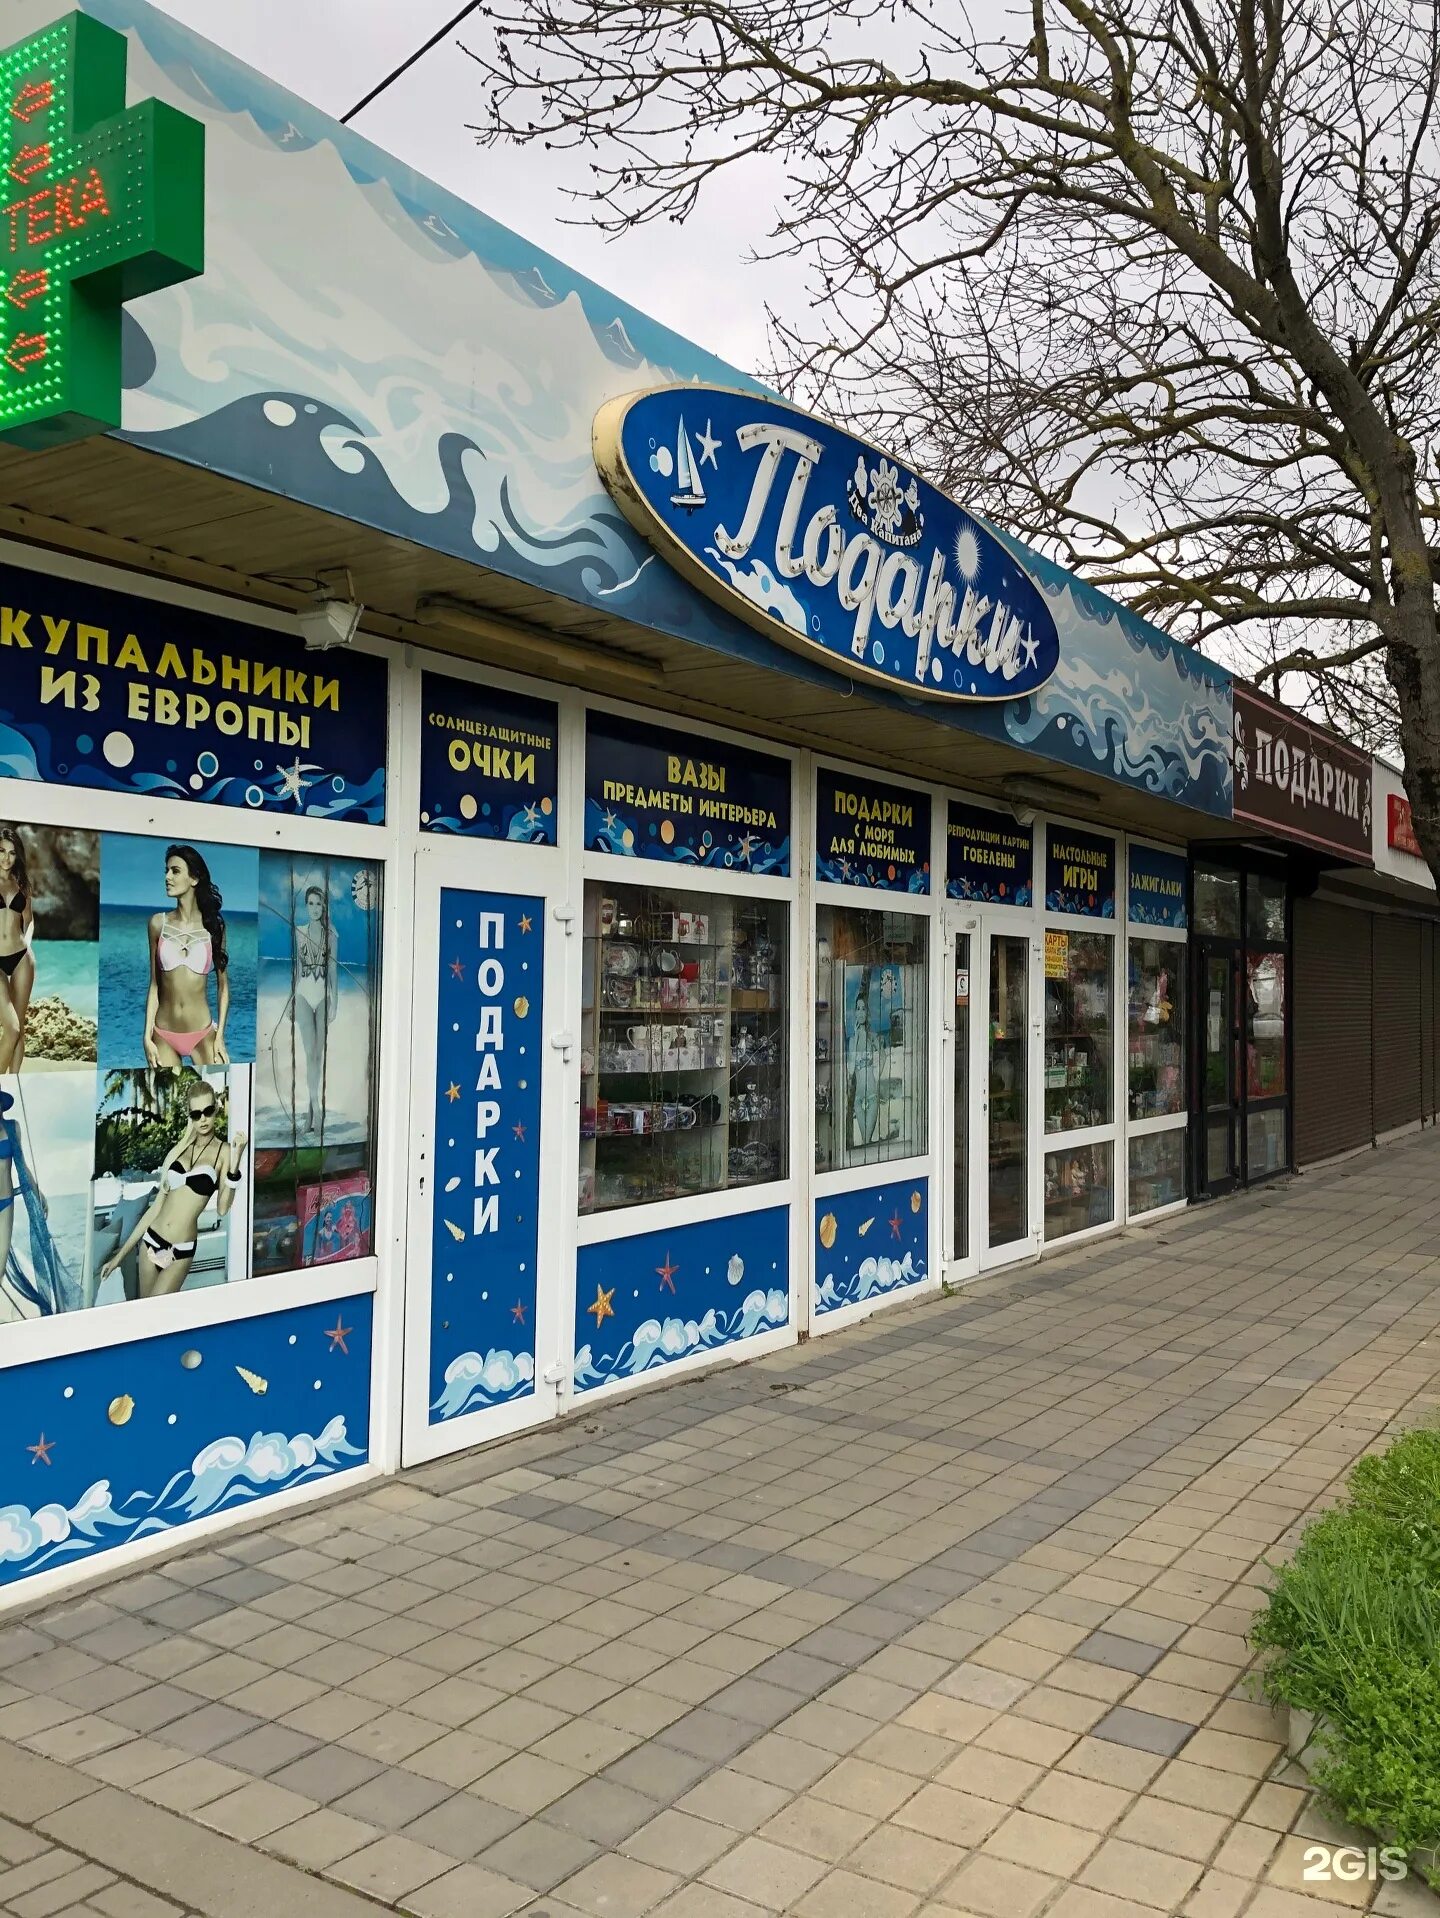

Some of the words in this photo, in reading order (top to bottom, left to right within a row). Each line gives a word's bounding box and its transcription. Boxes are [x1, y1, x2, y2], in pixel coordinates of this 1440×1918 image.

[870, 518, 923, 546] Капитана
[714, 423, 1026, 683] Подарки
[0, 606, 340, 712] КУПАЛЬНИКИ
[40, 666, 101, 712] ИЗ
[128, 682, 310, 749] ЕВРОПЫ
[428, 712, 551, 750] СОЛНЦЕЗАЩИТНЫЕ
[448, 739, 535, 785] ОЧКИ
[667, 755, 726, 793] ВАЗЫ
[1255, 727, 1359, 821] ПОДАРКИ
[603, 780, 693, 815] ПРЕДМЕТЫ
[699, 798, 777, 829] ИНТЕРЬЕРА
[834, 790, 913, 827] ПОДАРКИ
[830, 836, 855, 854] ДЛЯ
[859, 841, 915, 864] ЛЮБИМЫХ
[865, 825, 895, 844] МОРЯ
[947, 823, 1000, 845] РЕПРОДУКЦИИ
[1002, 835, 1030, 850] КАРТИН
[963, 845, 1016, 868] ГОБЕЛЕНЫ
[1053, 843, 1107, 868] НАСТОЛЬНЫЕ
[1063, 865, 1098, 892] ИГРЫ
[1131, 872, 1182, 898] ЗАЖИГАЛКИ
[473, 911, 505, 1236] ПОДАРКИ
